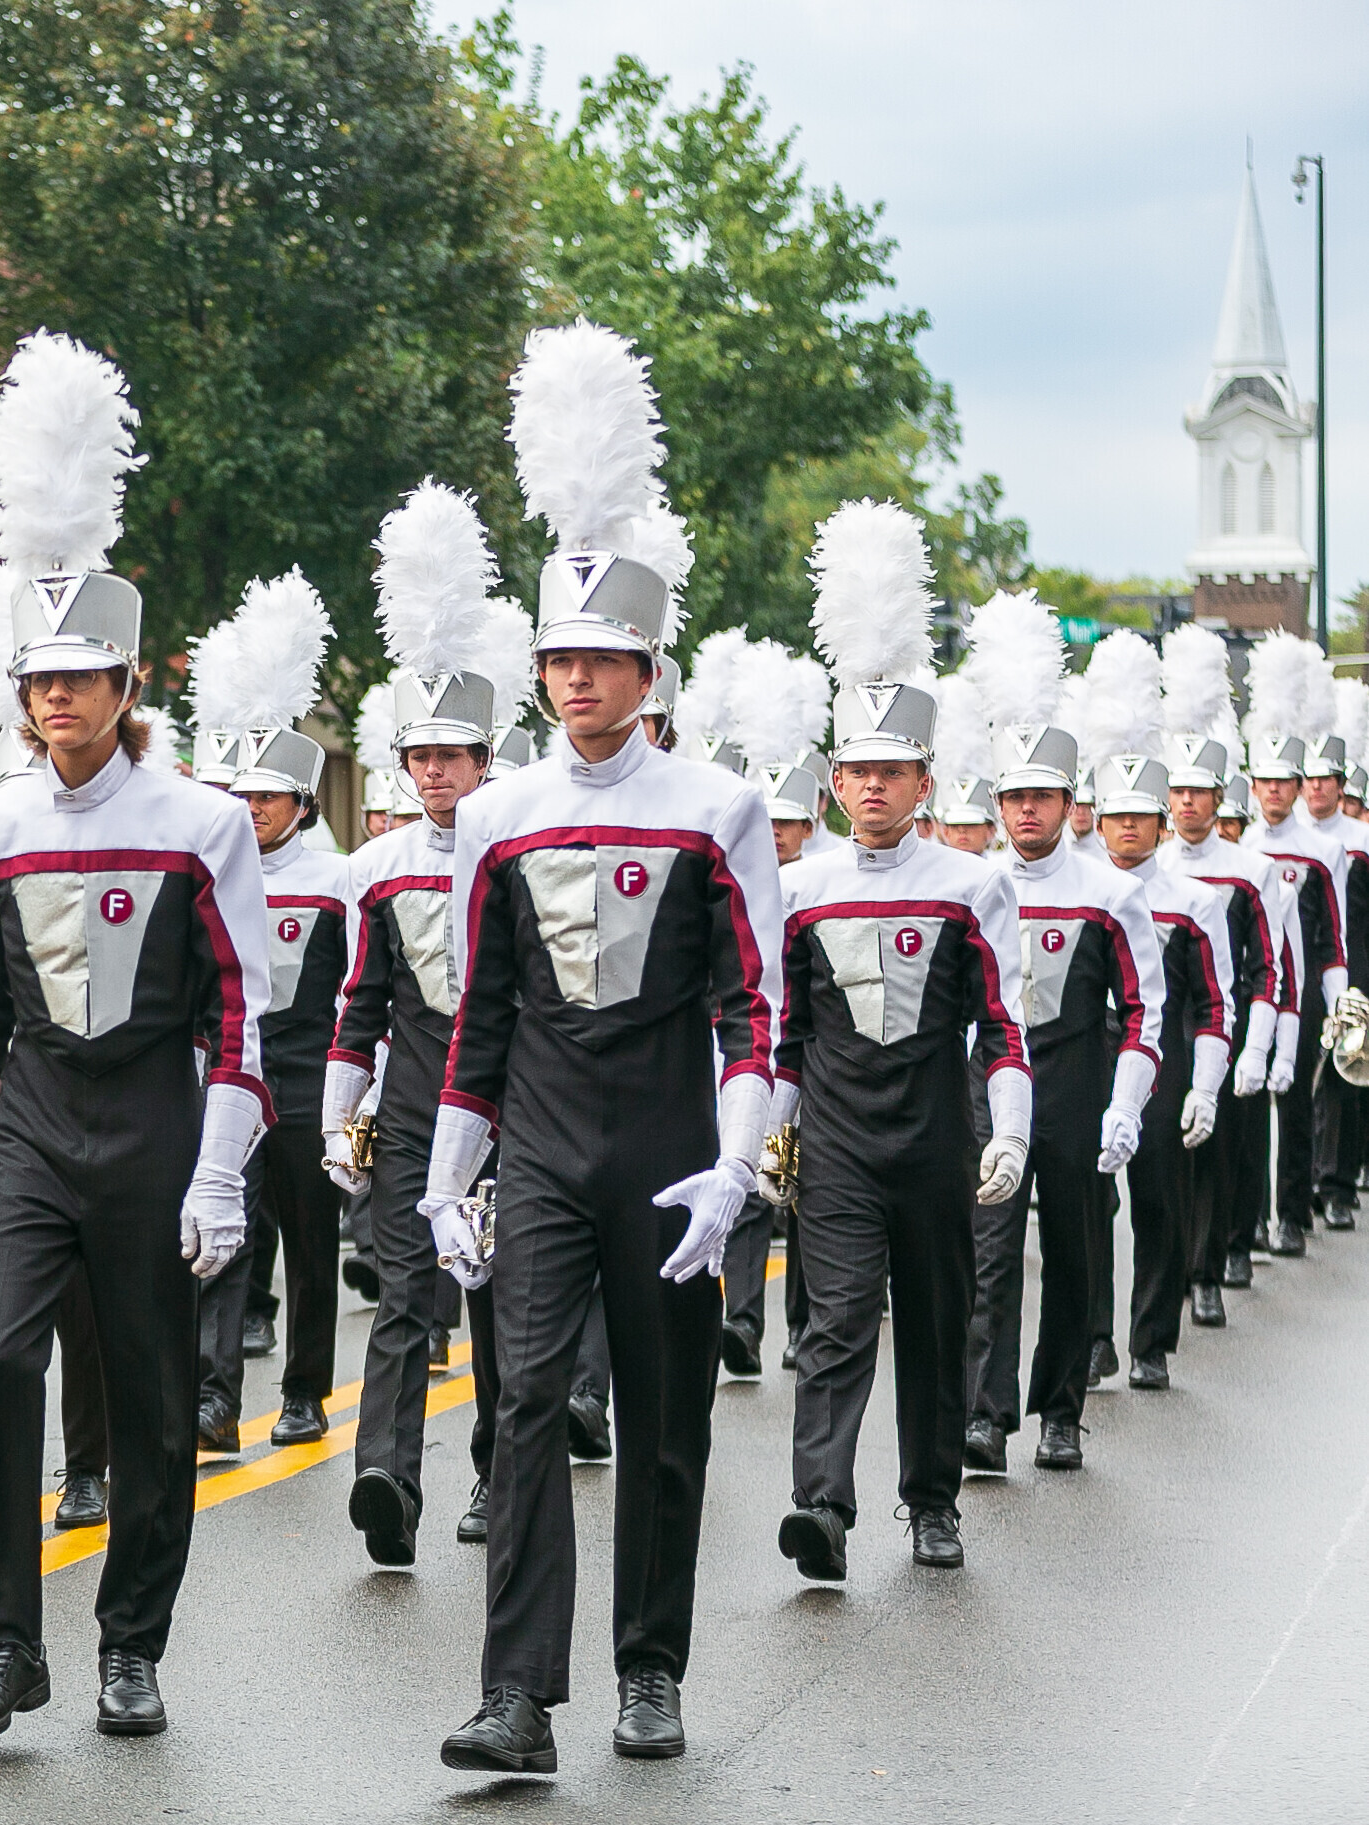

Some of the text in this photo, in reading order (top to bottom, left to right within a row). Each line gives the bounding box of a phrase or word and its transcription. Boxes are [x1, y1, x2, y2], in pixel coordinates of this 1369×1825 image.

[622, 867, 641, 892] F
[108, 894, 126, 918] F
[284, 922, 296, 939] F
[1047, 932, 1060, 950] F
[901, 932, 915, 953] F
